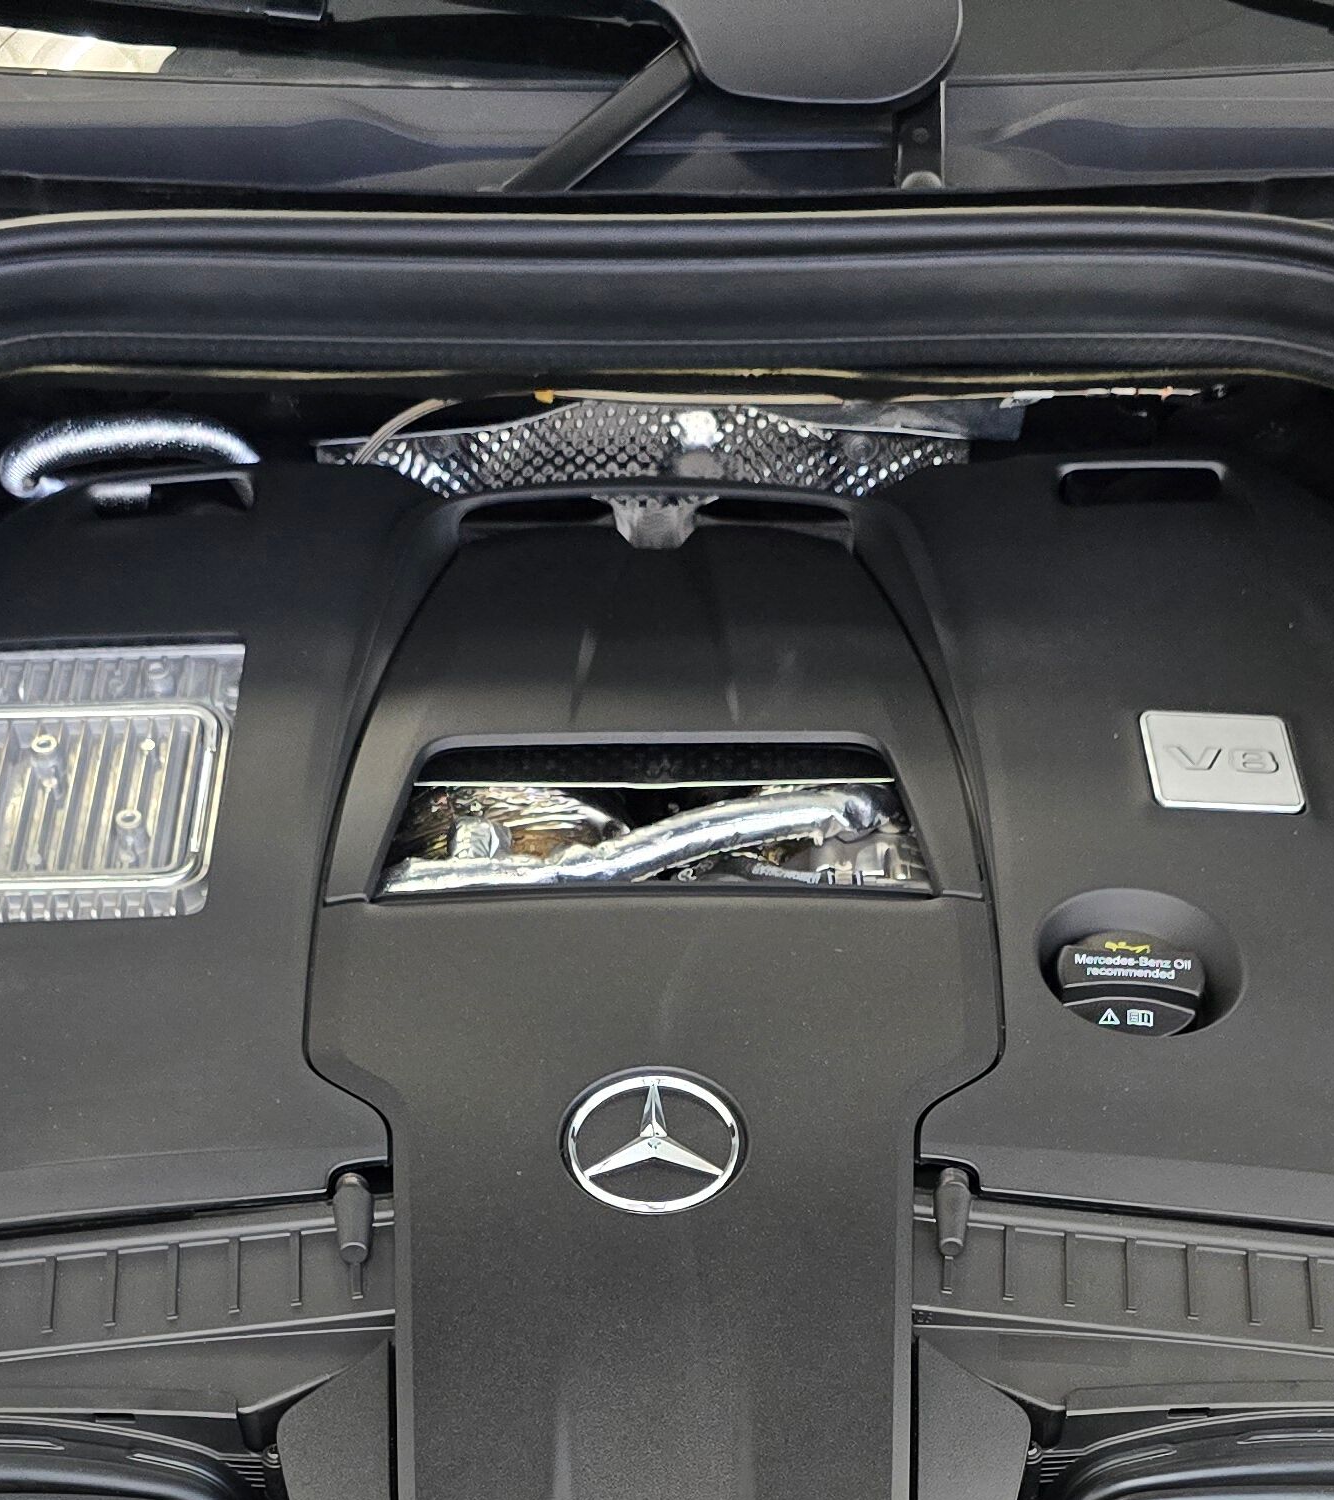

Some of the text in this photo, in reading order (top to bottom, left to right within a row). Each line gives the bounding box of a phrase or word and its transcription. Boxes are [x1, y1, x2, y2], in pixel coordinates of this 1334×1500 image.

[1166, 745, 1279, 774] V8
[1074, 953, 1192, 970] Mercedes-Benz Oil
[1086, 966, 1175, 980] recommended
